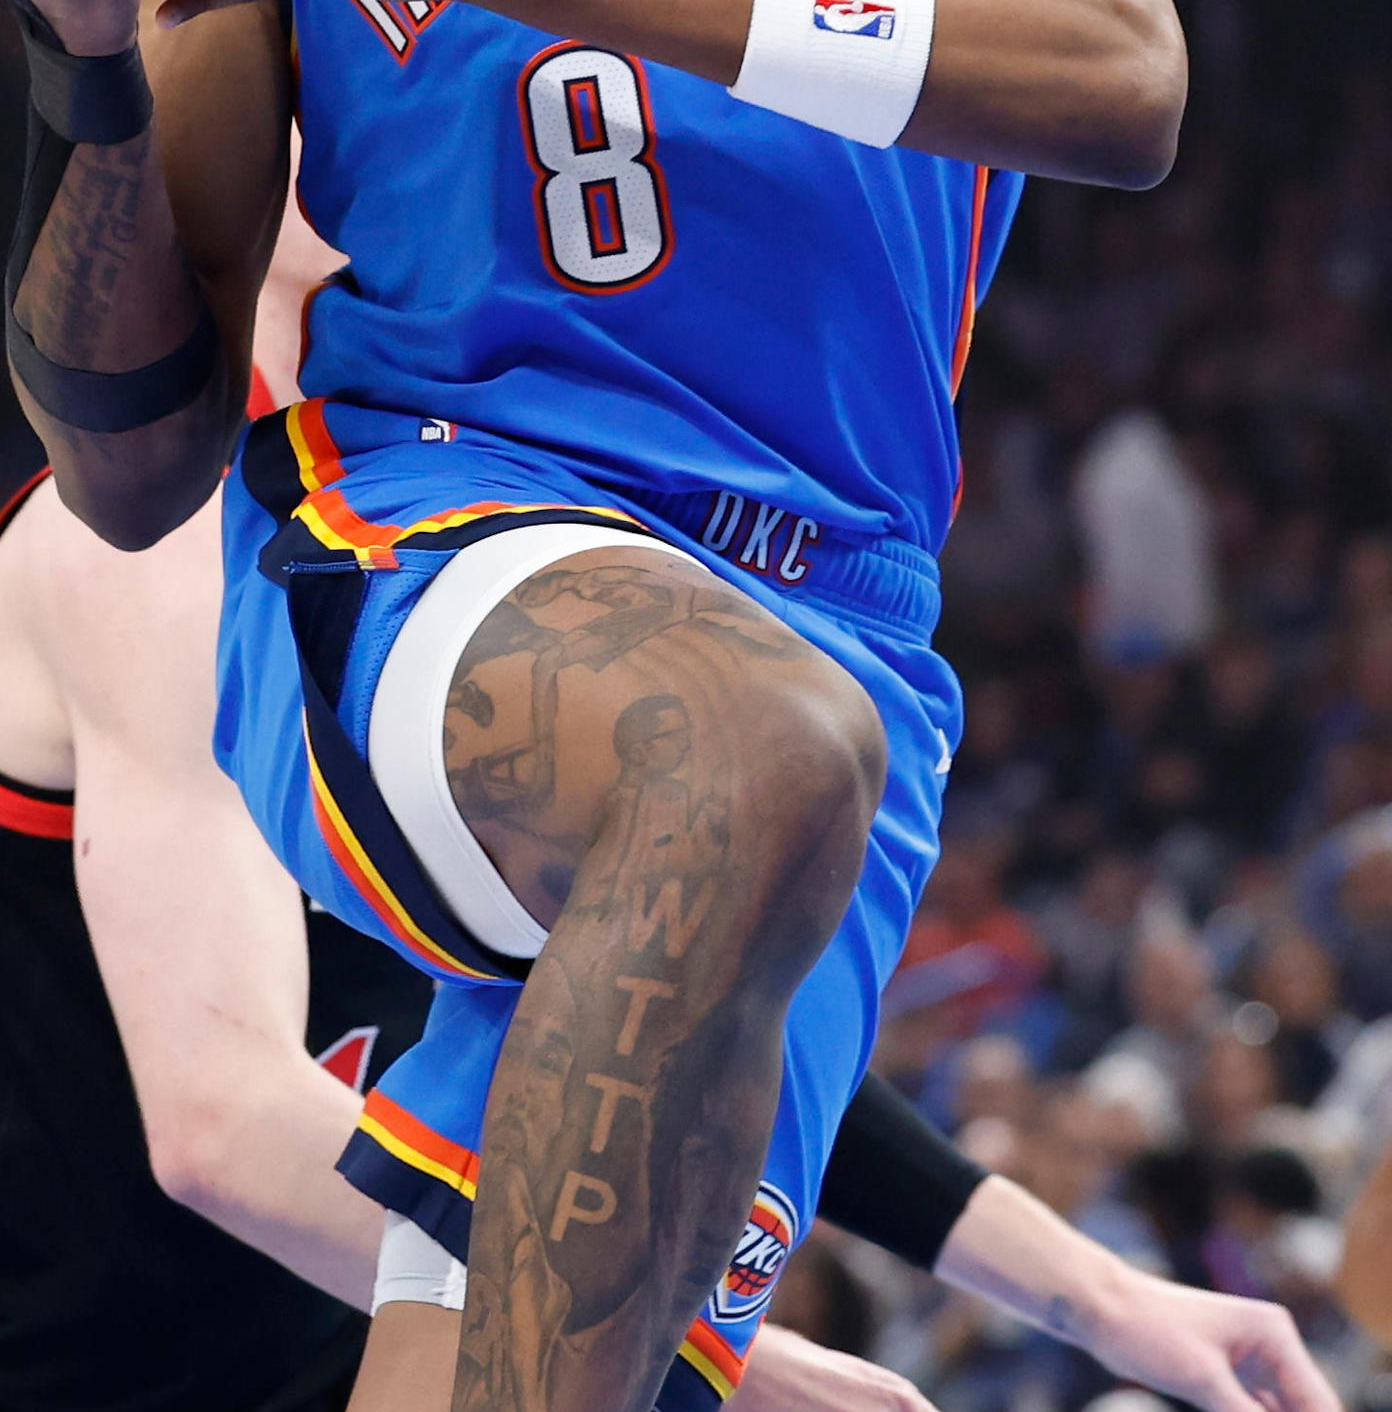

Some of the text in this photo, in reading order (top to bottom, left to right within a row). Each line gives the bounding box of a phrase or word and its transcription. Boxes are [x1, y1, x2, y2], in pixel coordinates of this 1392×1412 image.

[516, 38, 676, 296] 8
[421, 426, 442, 441] NBA
[699, 488, 820, 585] OKC
